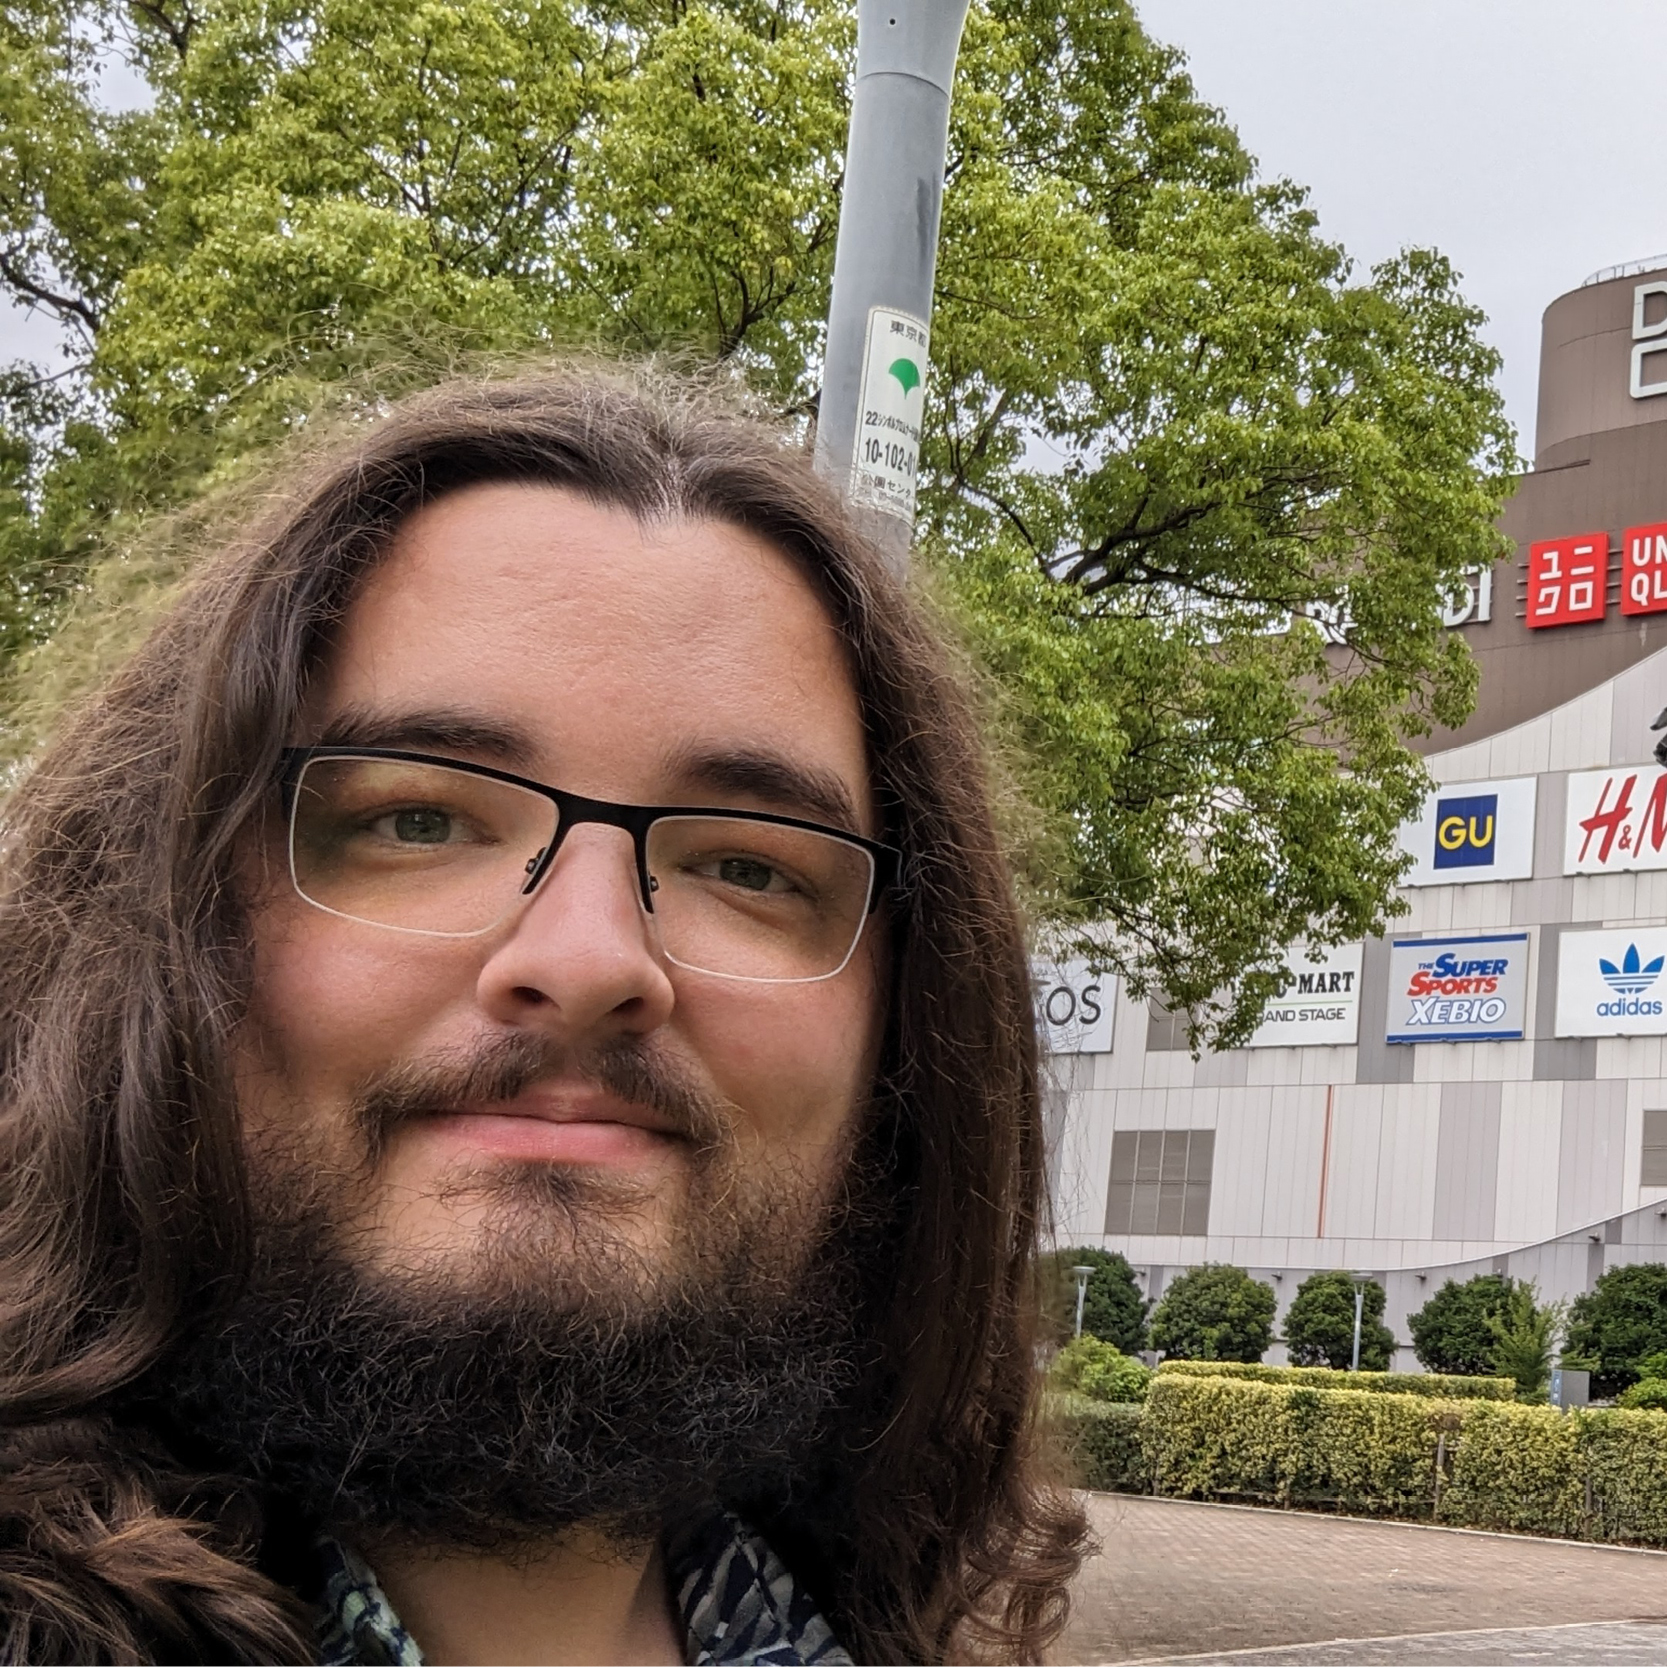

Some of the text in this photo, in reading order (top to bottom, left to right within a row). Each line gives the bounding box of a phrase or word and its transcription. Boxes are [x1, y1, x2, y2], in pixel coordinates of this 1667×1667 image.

[890, 320, 927, 348] 東京都
[1438, 815, 1493, 850] GU
[1418, 952, 1509, 978] THE SUPER
[1407, 971, 1498, 996] SPORTS
[1298, 1007, 1346, 1021] STAGE
[1405, 996, 1507, 1026] XEBIO
[1596, 998, 1663, 1017] adidas
